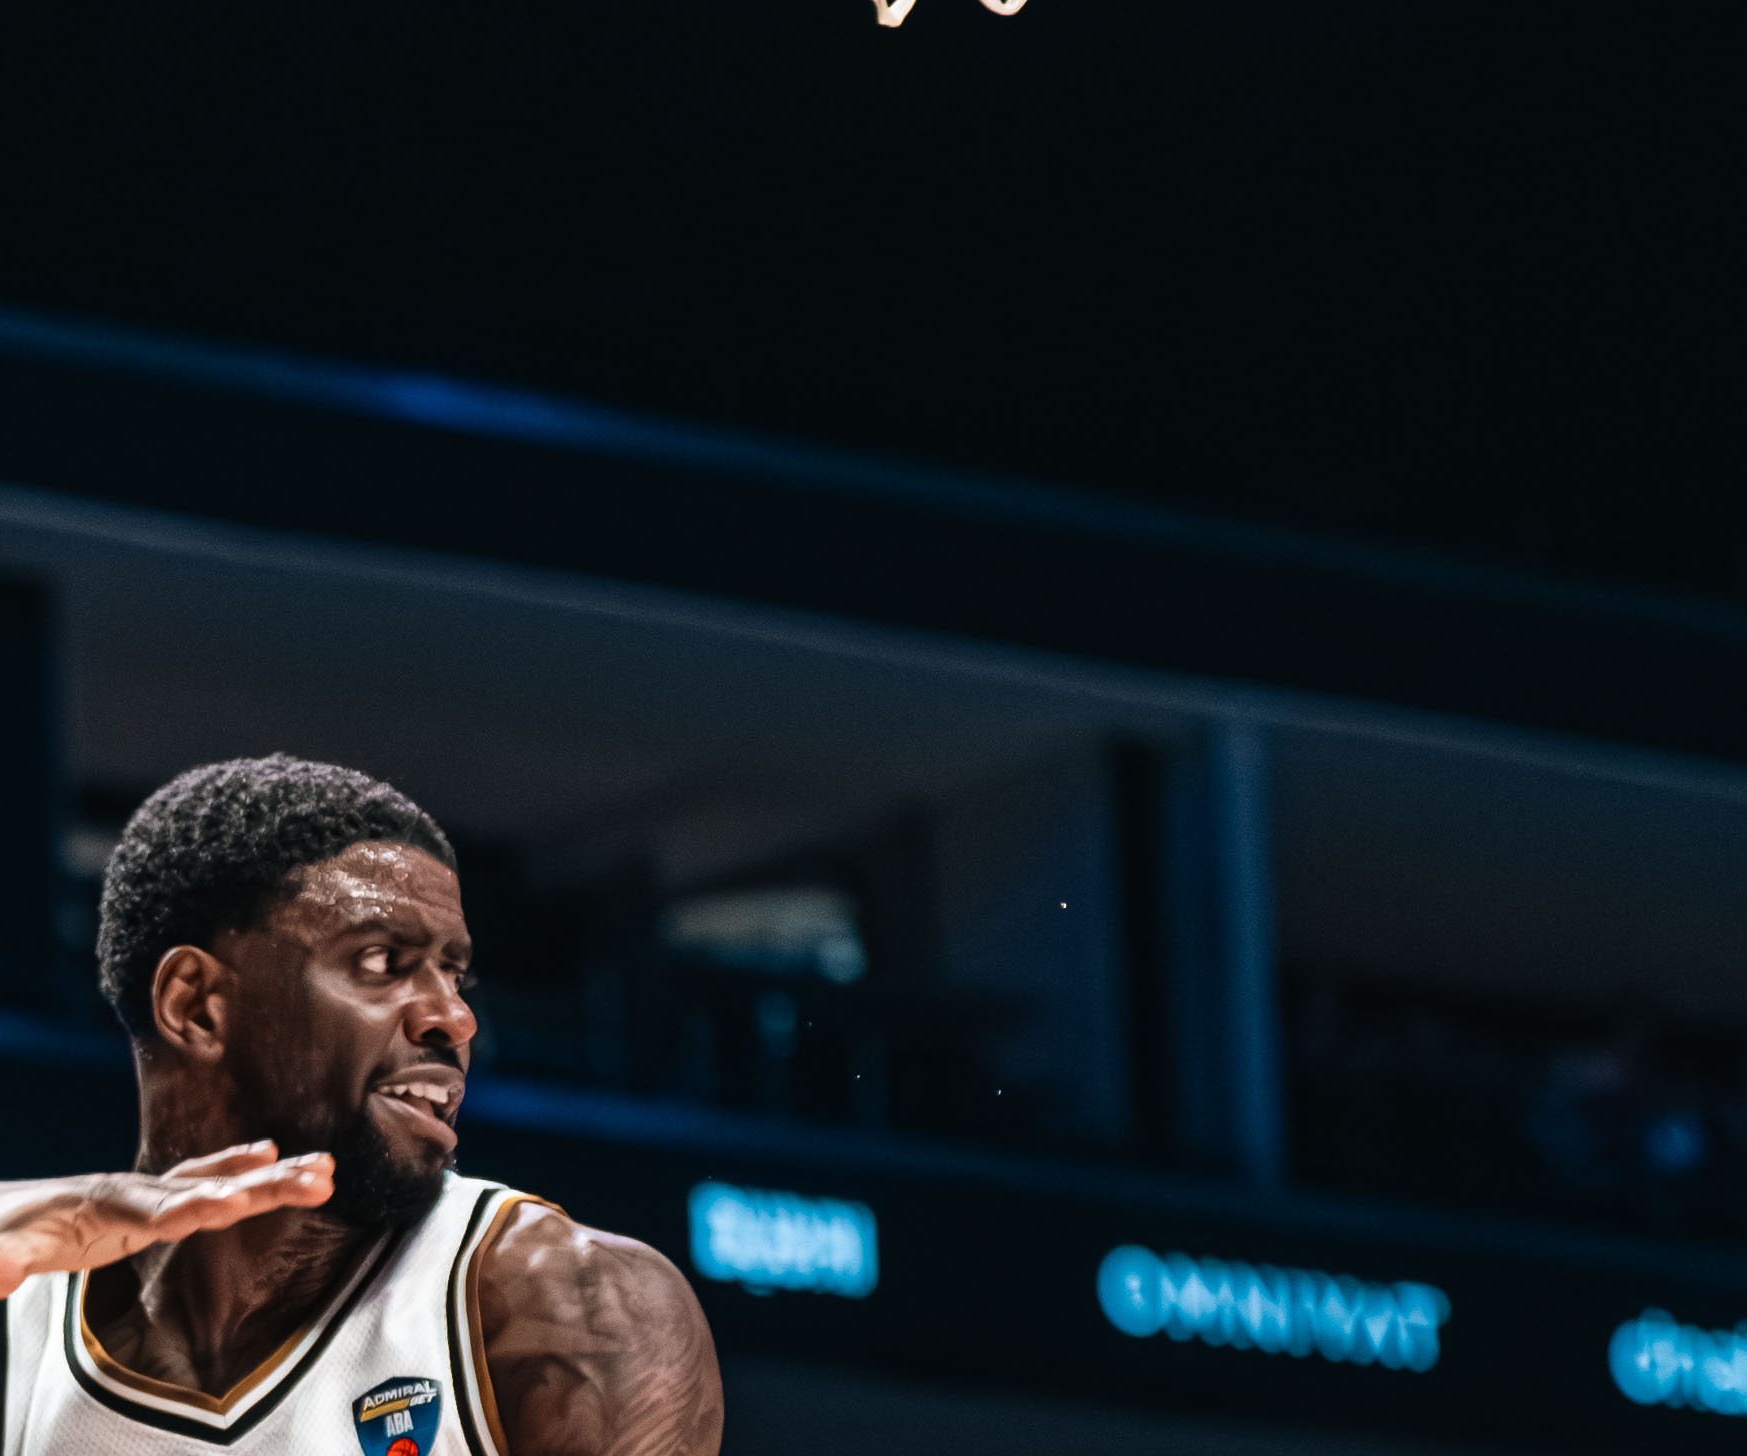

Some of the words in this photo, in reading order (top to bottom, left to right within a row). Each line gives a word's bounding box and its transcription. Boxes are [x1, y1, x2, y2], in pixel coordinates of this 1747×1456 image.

[363, 1381, 437, 1411] ADMIRAL
[409, 1393, 437, 1407] BET
[386, 1409, 414, 1438] ABA
